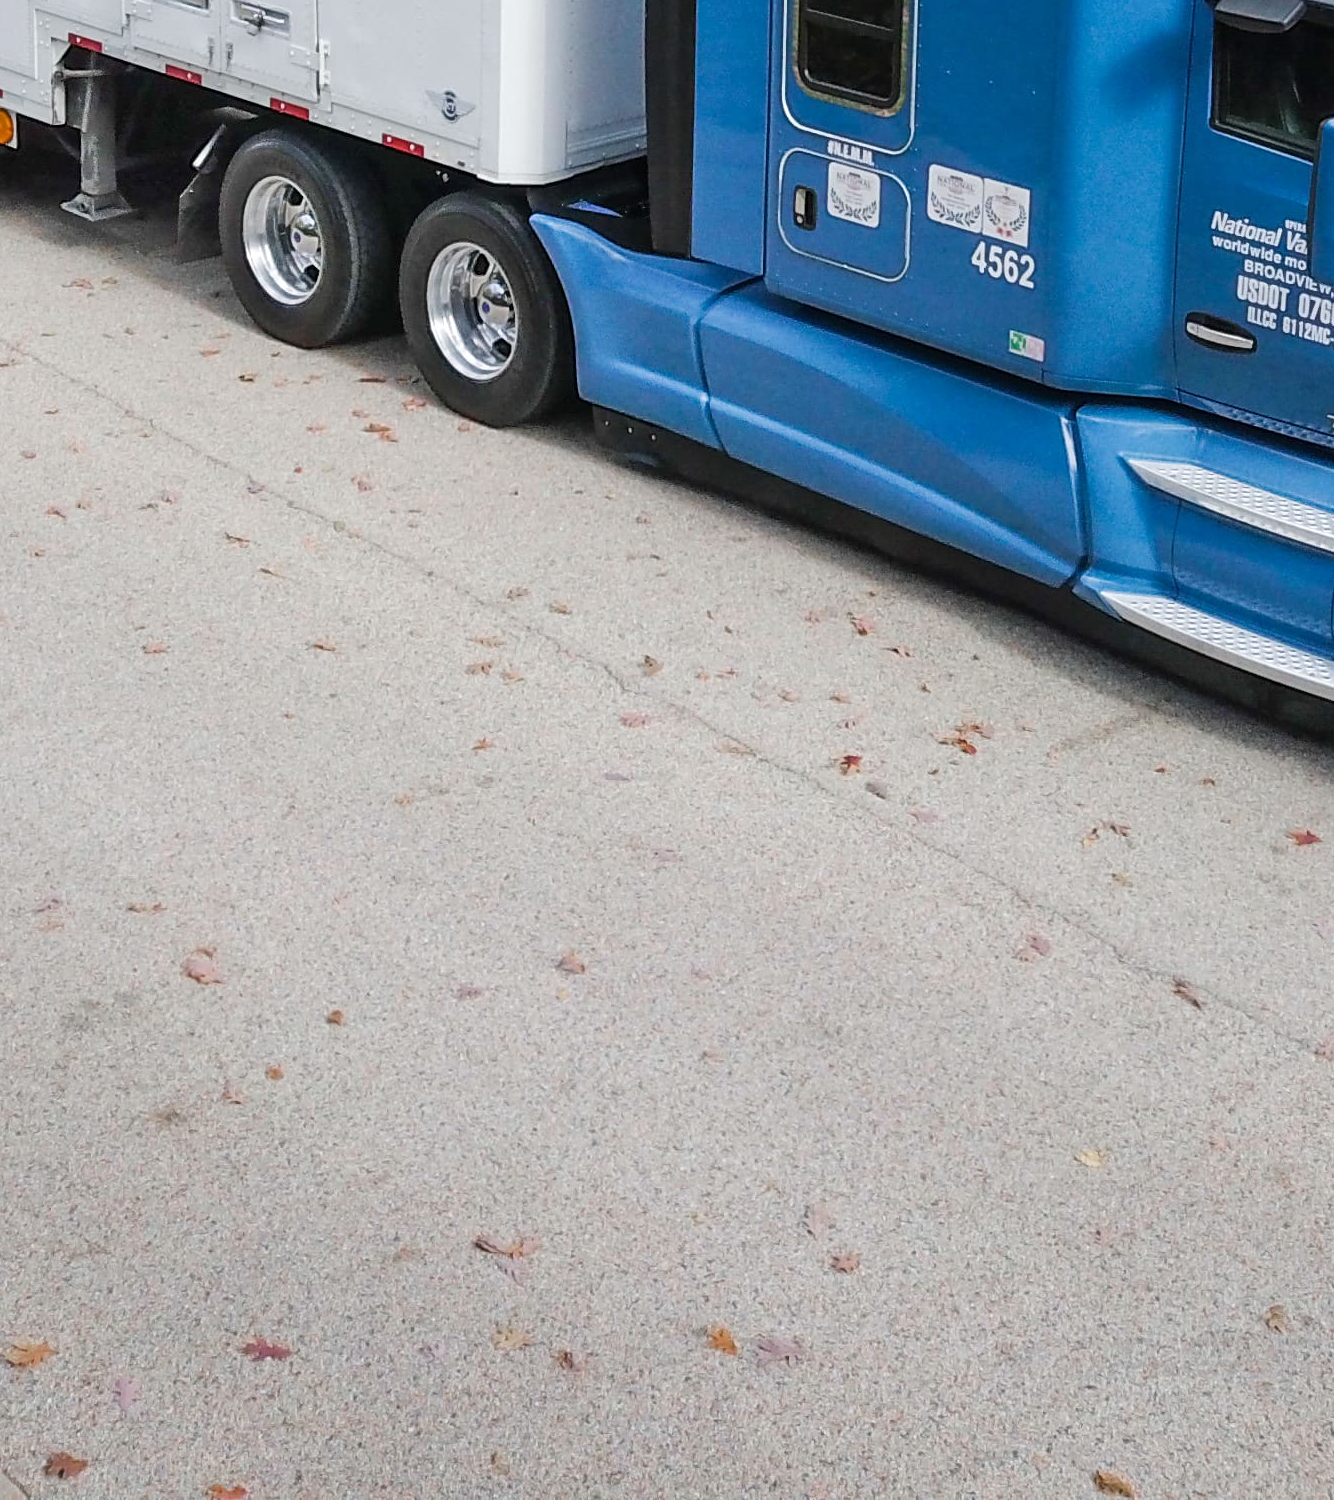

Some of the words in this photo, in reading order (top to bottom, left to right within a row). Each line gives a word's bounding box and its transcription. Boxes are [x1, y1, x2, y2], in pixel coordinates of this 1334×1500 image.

[1210, 210, 1283, 247] National
[1286, 230, 1307, 255] Va
[1211, 235, 1282, 264] worldwide
[971, 240, 1036, 290] 4562
[1244, 259, 1334, 299] BROADVIEW,
[1236, 274, 1291, 312] USDOT
